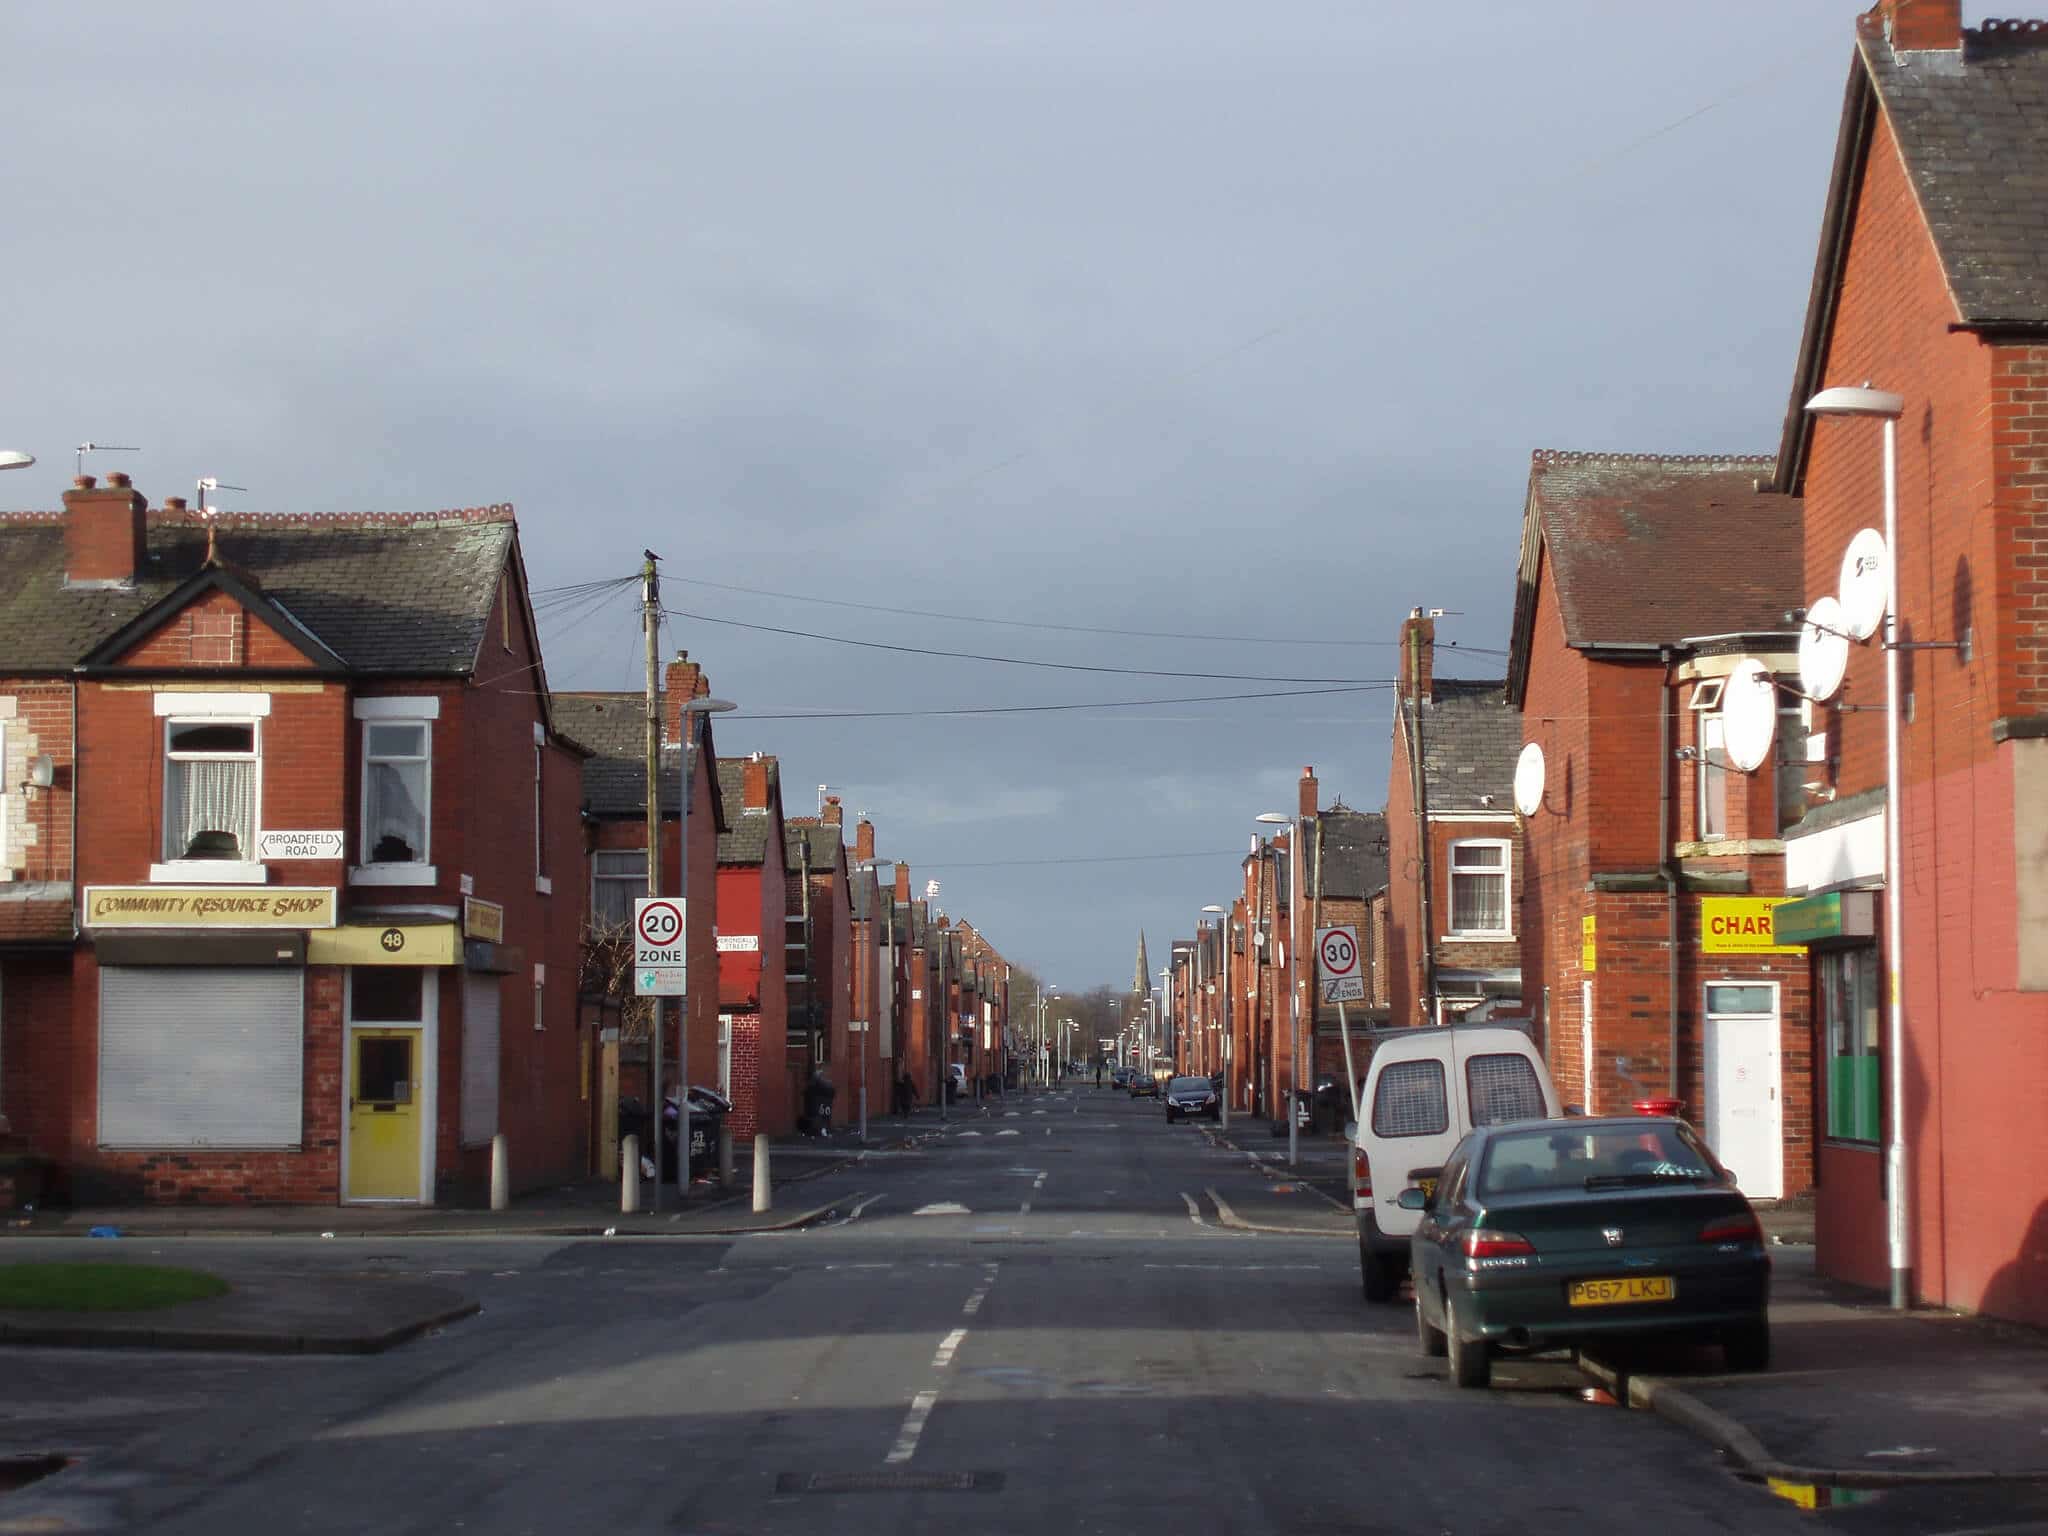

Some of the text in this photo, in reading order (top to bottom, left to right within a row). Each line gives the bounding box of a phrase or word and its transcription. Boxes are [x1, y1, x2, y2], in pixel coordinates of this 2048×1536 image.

[268, 834, 334, 844] BROADFIELD
[285, 845, 318, 856] ROAD
[95, 897, 324, 917] COMMUNITY RESOURCE SHOP
[646, 915, 676, 933] 20
[383, 933, 402, 947] 48
[640, 950, 681, 962] ZONE
[1326, 943, 1352, 962] 30
[1341, 988, 1362, 998] ENDS
[1482, 1257, 1528, 1267] PEUGEOT
[1573, 1278, 1666, 1300] P667 LKJ
